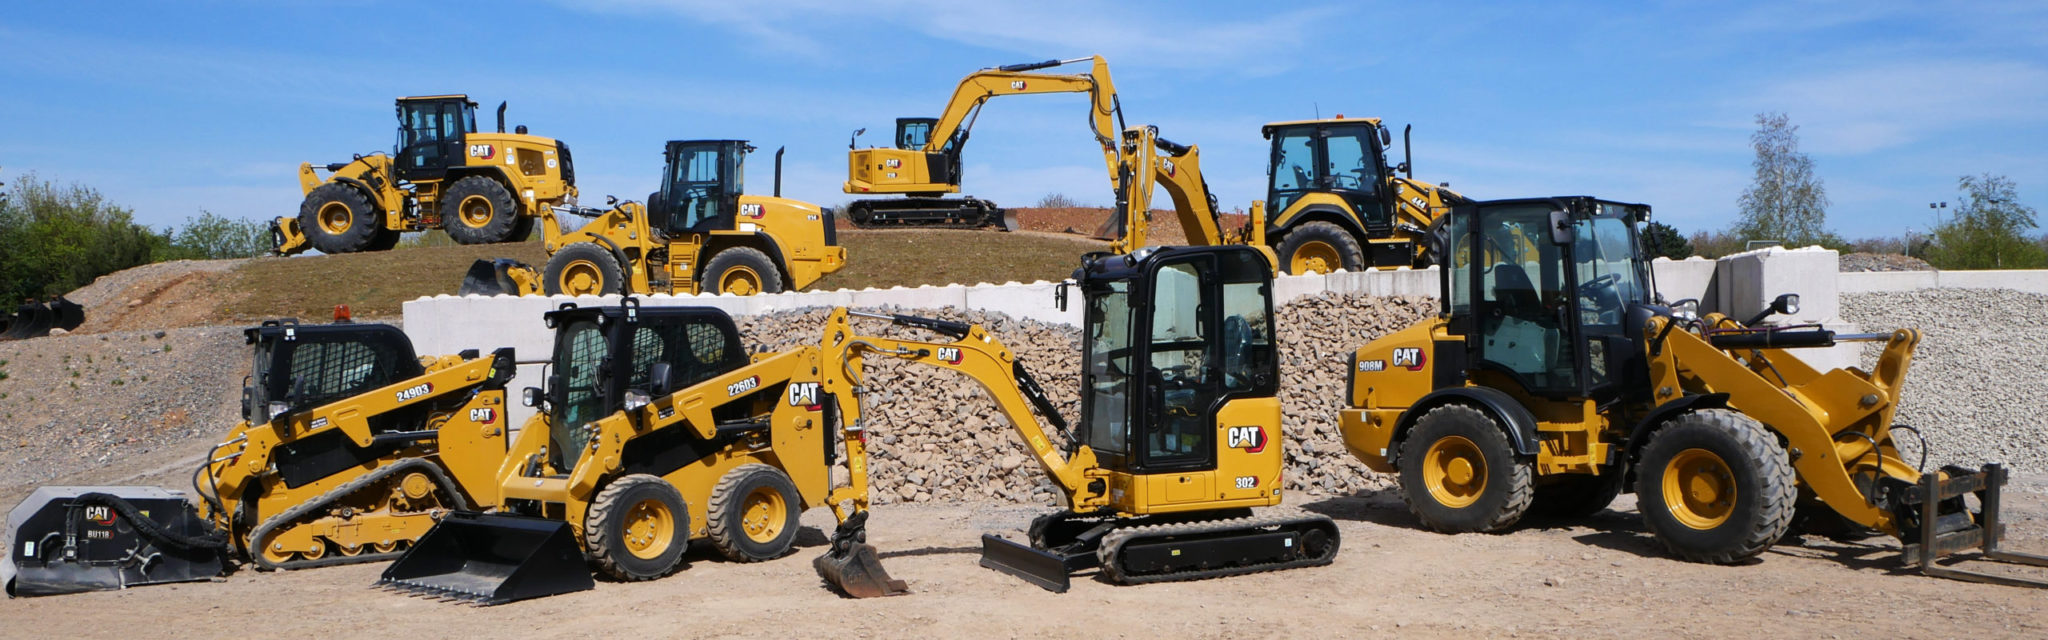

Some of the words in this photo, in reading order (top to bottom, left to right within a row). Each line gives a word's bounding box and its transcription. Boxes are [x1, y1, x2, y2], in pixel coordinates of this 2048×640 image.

[1011, 81, 1024, 89] CAT
[470, 144, 490, 157] CAT
[886, 159, 898, 167] CAT
[1164, 158, 1174, 174] CAT
[1411, 197, 1427, 208] 444
[741, 204, 760, 216] CAT
[937, 347, 958, 361] CAT
[1393, 348, 1419, 367] CAT
[1358, 361, 1383, 371] 908M
[396, 383, 430, 402] 249D3
[727, 376, 758, 397] 226D3
[789, 382, 819, 406] CAT
[470, 408, 491, 422] CAT
[1228, 426, 1259, 448] CAT
[1235, 476, 1255, 489] 302
[86, 506, 109, 520] CAT
